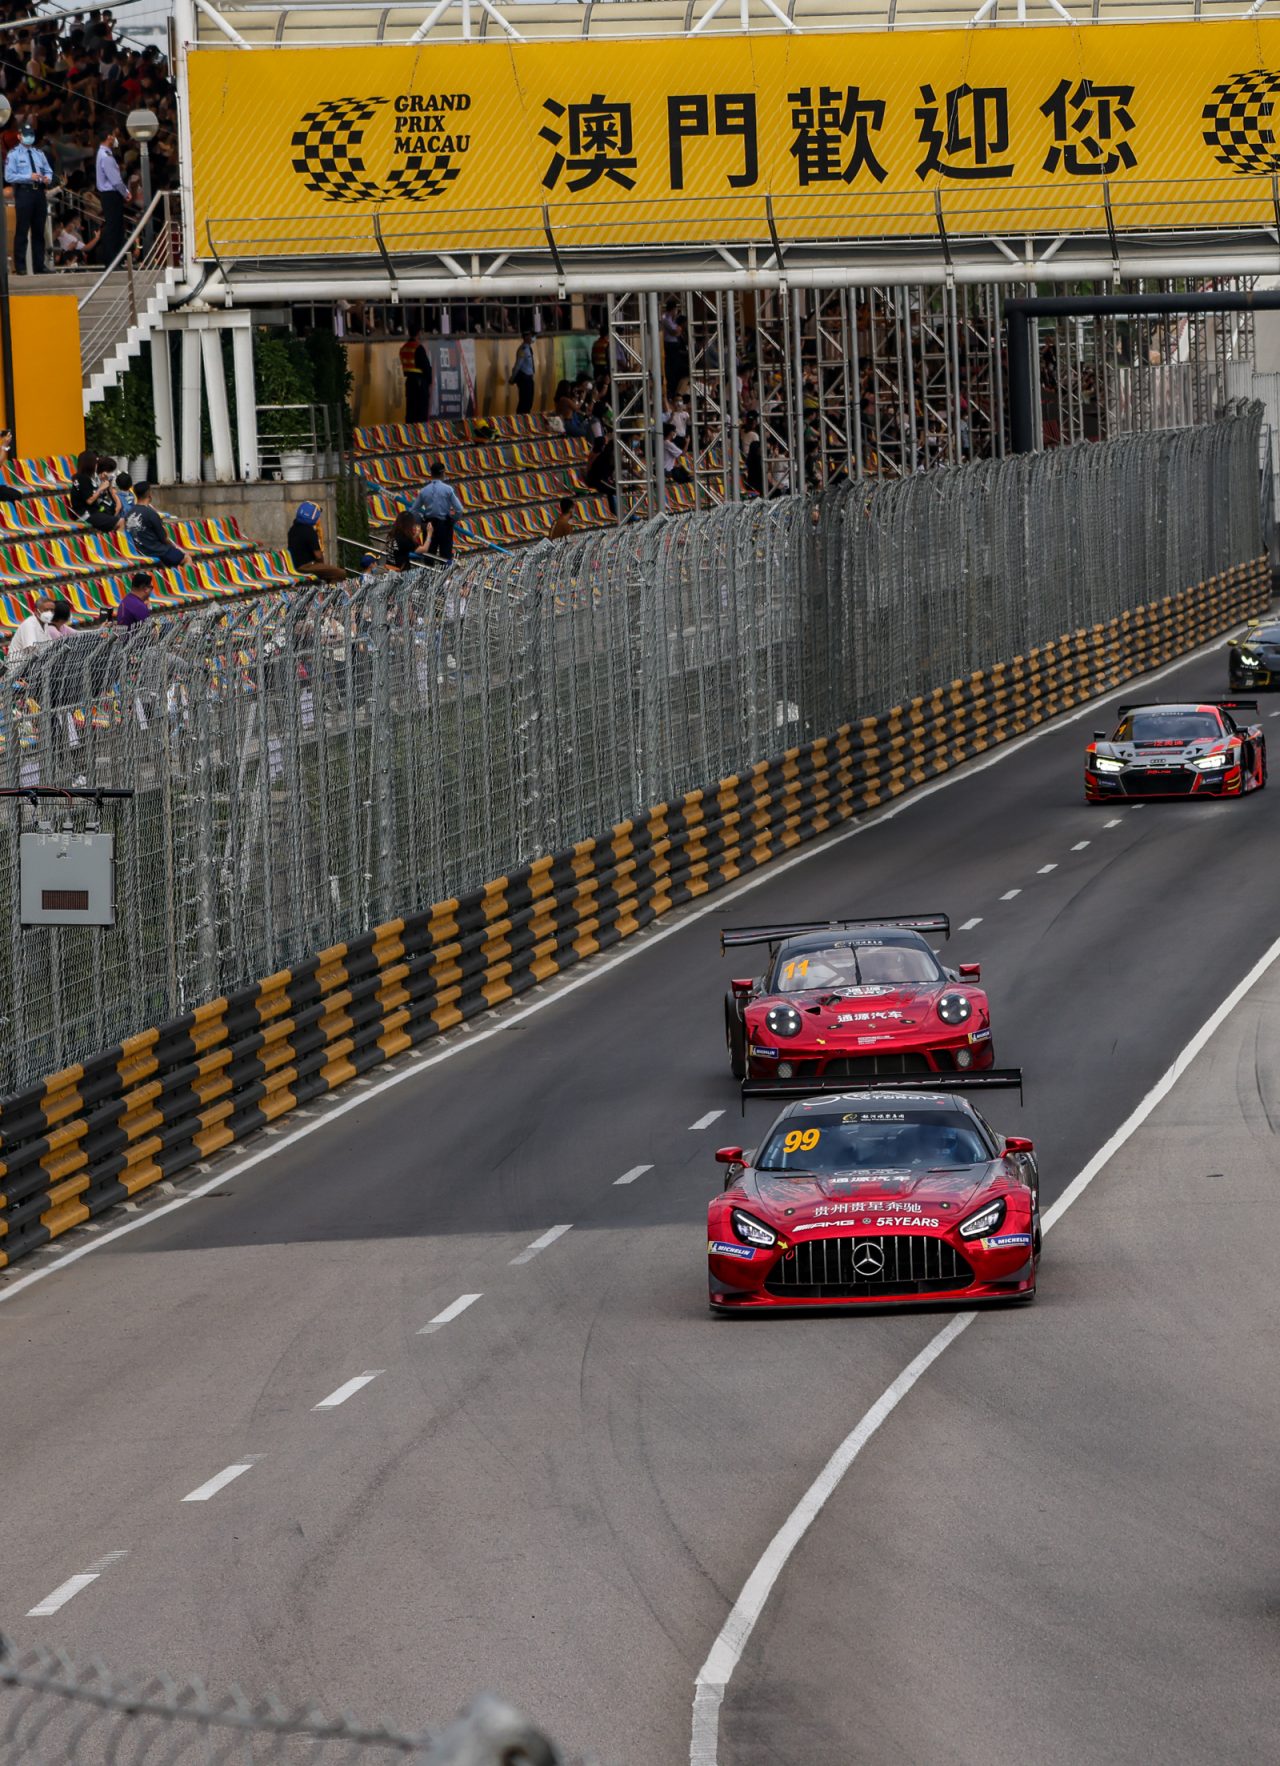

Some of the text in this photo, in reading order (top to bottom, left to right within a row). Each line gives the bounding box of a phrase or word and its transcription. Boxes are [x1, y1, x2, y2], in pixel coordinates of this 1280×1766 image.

[393, 94, 471, 113] GRAND
[393, 114, 446, 133] PRIX
[393, 134, 471, 154] MACAU
[537, 78, 1139, 193] 澳門歡迎您
[783, 958, 810, 980] 11
[782, 1127, 821, 1154] 99
[997, 1236, 1030, 1245] MICHELIN
[717, 1245, 751, 1256] MICHELIN
